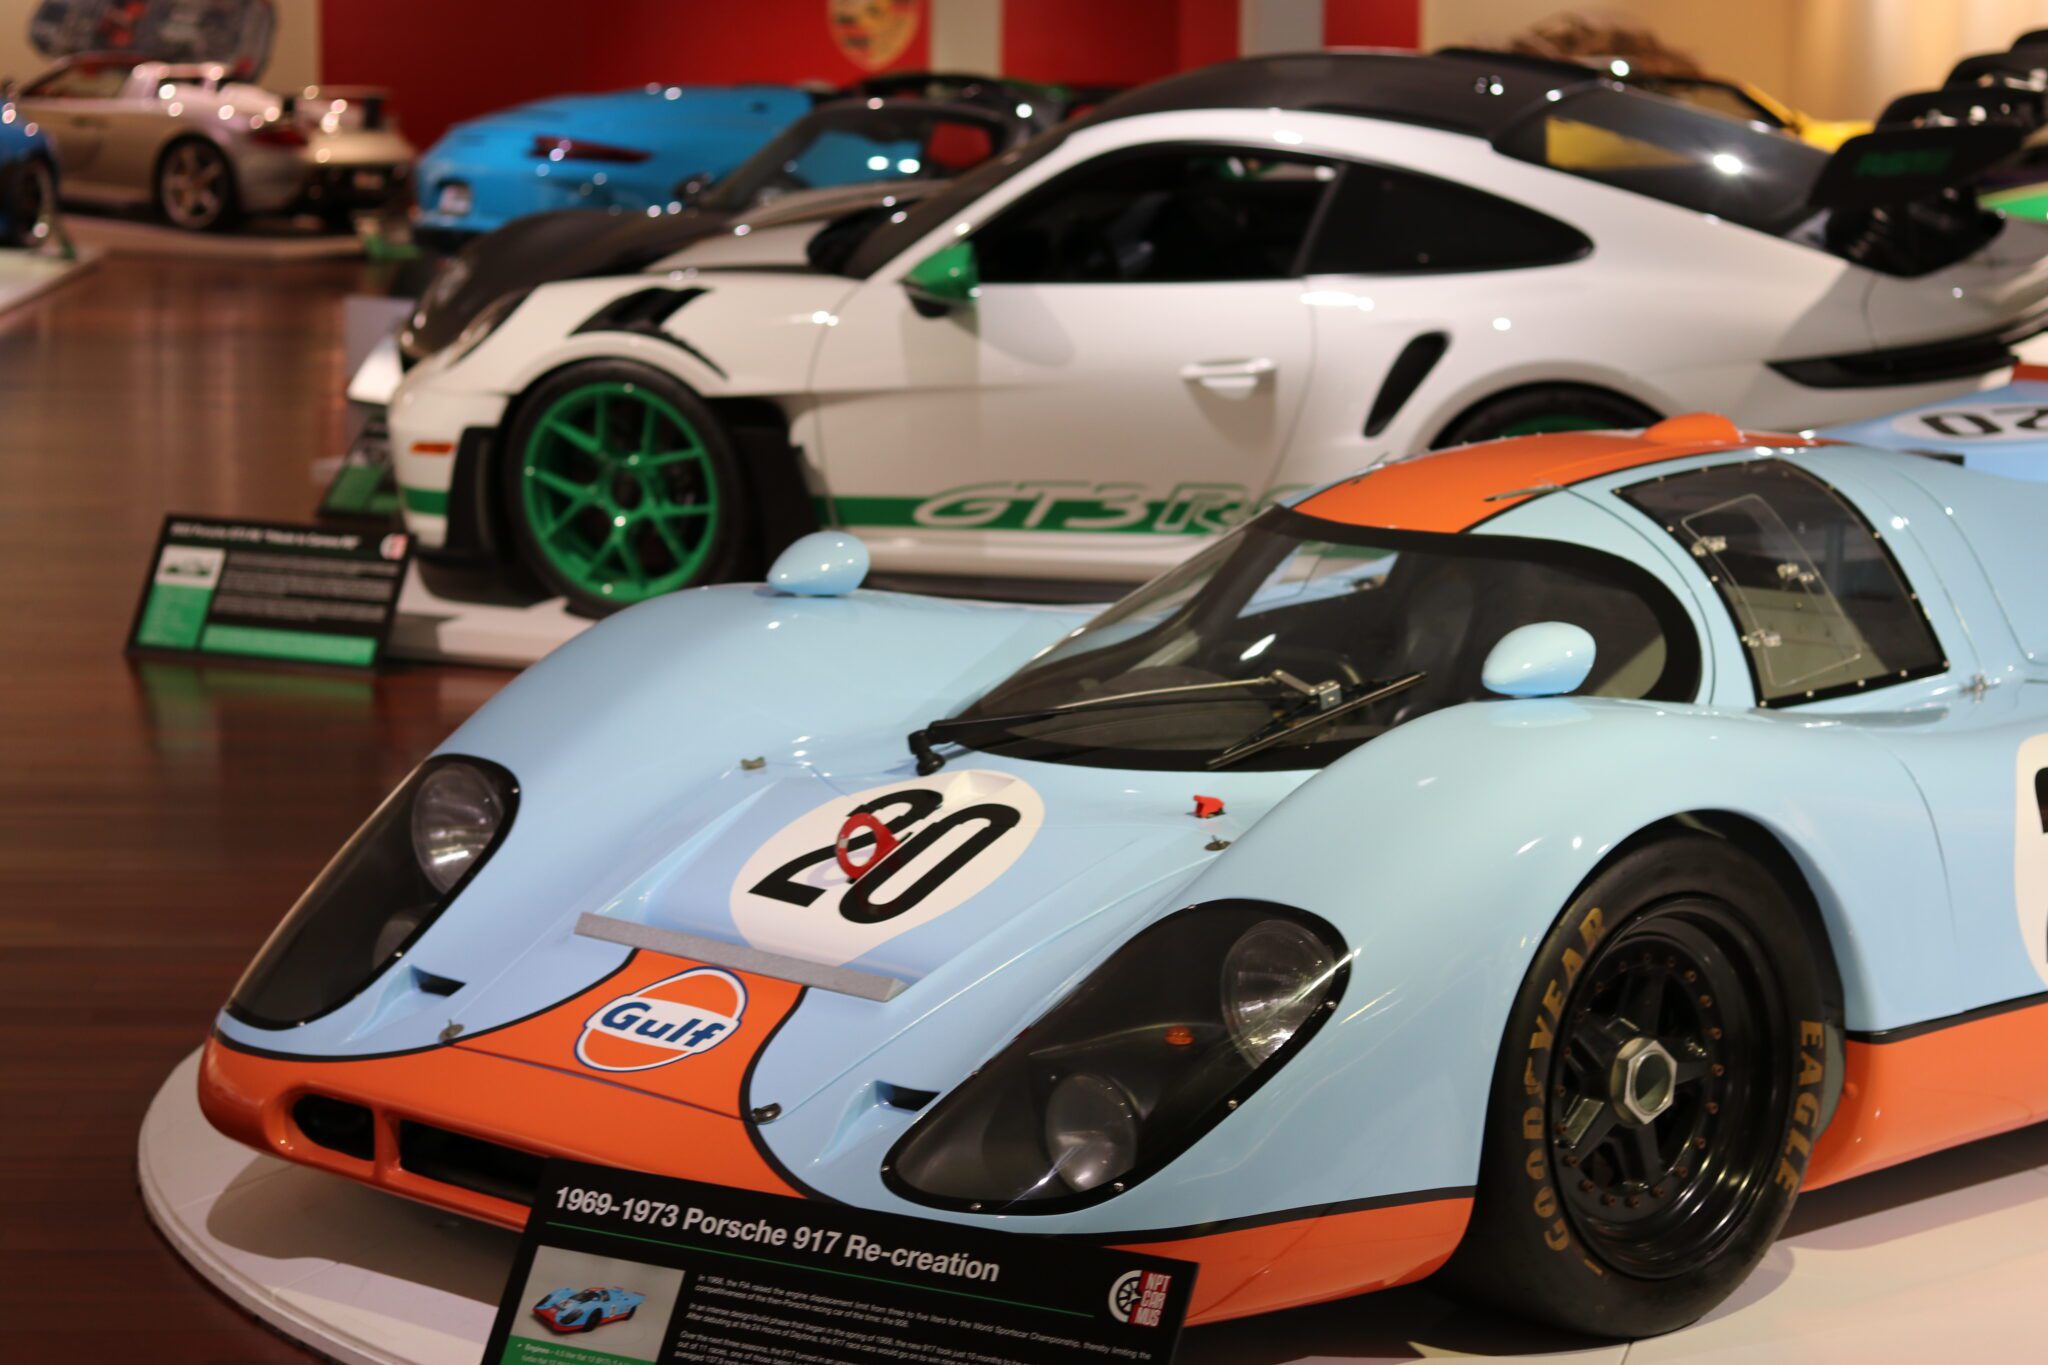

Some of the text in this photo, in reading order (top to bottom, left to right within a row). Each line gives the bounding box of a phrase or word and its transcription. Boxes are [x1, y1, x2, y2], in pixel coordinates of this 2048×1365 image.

[747, 788, 1021, 924] 20
[600, 1001, 727, 1048] Gulf
[1523, 907, 1606, 1251] GOODYEAR
[1776, 1019, 1824, 1200] EAGLE
[556, 1186, 999, 1282] 1969-1973 Porsche 917 Re-creation
[1134, 1307, 1161, 1327] MUS
[1145, 1273, 1171, 1292] NPT
